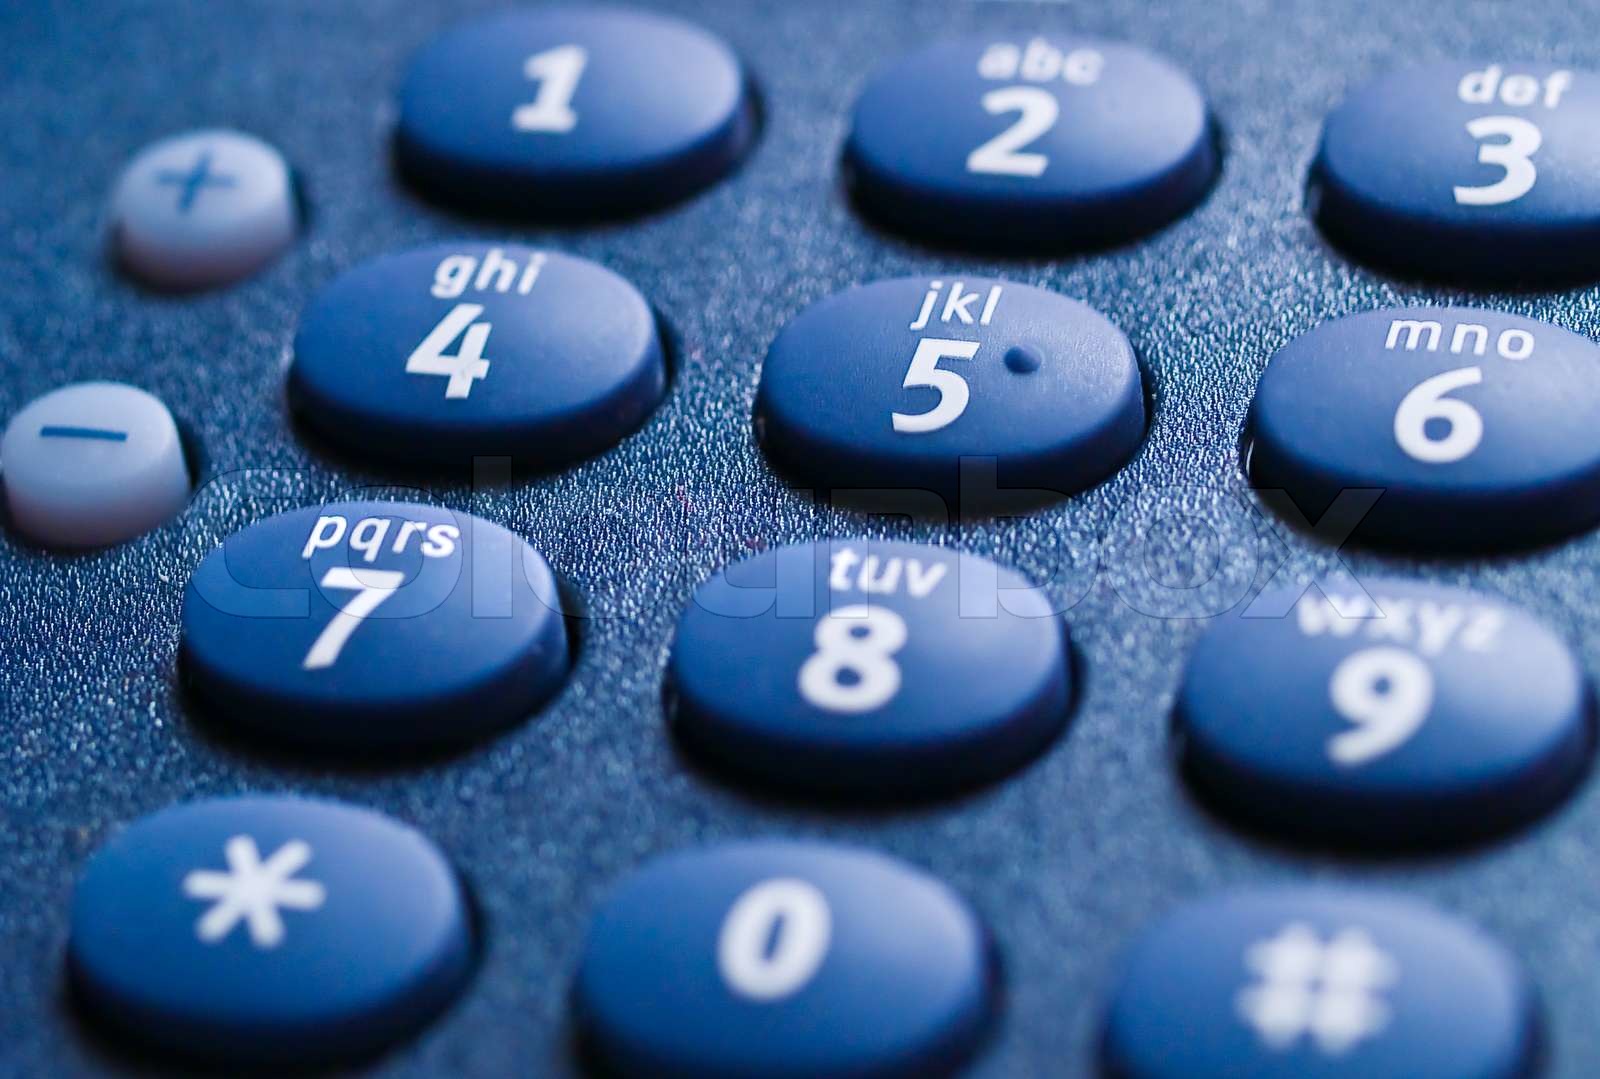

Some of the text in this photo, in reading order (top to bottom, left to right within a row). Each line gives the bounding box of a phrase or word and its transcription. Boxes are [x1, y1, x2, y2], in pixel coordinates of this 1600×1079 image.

[513, 44, 588, 132] 1
[977, 37, 1105, 85] abc
[1457, 65, 1574, 108] def
[967, 85, 1059, 176] 2
[1453, 115, 1542, 205] 3
[430, 248, 548, 299] ghi
[909, 280, 1003, 331] jkl
[405, 302, 493, 399] 4
[891, 337, 981, 432] 5
[1384, 319, 1536, 361] mno
[1393, 366, 1483, 464] 6
[301, 514, 461, 562] pqrs
[829, 547, 947, 598] tuv
[302, 566, 406, 670] 7
[798, 603, 907, 713] 8
[1328, 645, 1435, 764] 9
